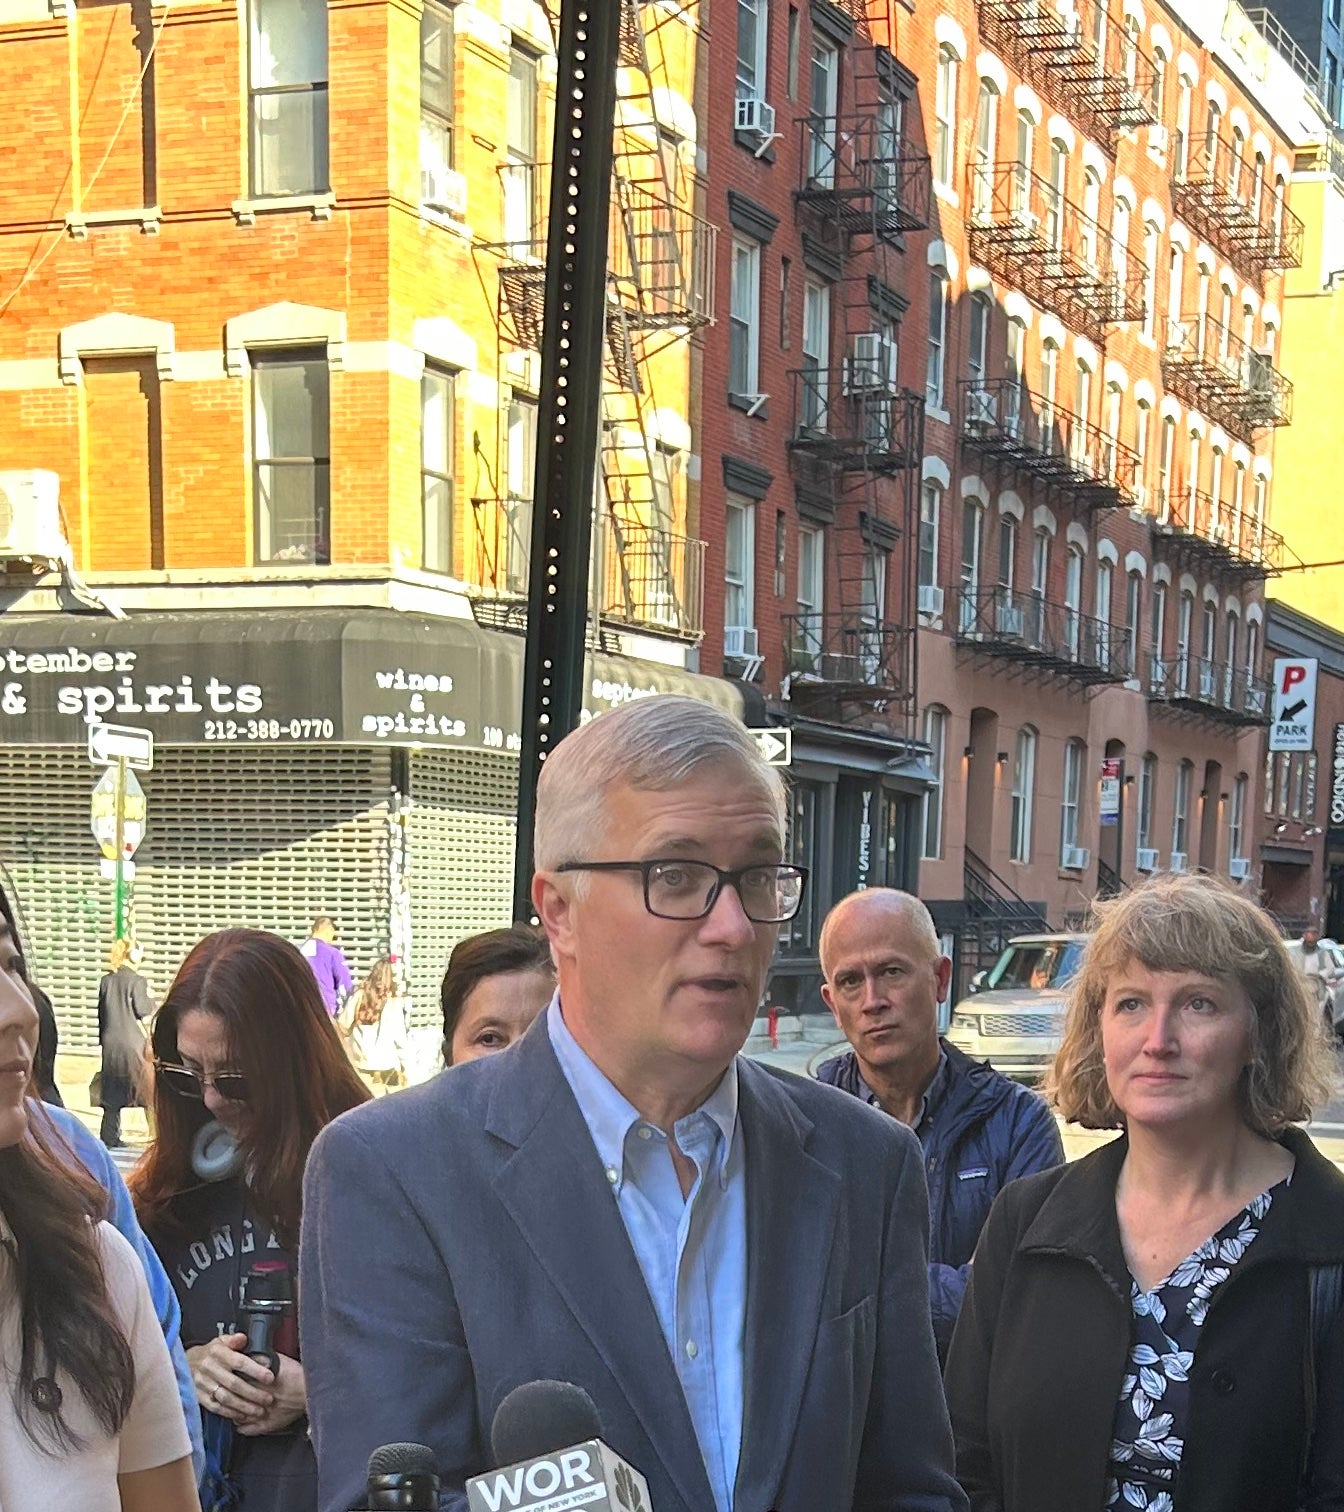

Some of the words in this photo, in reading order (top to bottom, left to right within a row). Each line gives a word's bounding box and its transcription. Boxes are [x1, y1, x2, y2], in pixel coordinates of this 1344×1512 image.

[375, 667, 454, 693] wines
[592, 678, 657, 708] septe
[1281, 666, 1307, 695] P
[1, 681, 27, 715] &
[57, 675, 263, 724] spirits
[410, 694, 425, 713] &
[204, 718, 334, 740] 212-388-0770
[362, 712, 466, 738] spirits
[1276, 725, 1308, 737] PARK
[476, 1450, 595, 1512] WOR
[547, 1499, 570, 1512] NEW
[571, 1489, 597, 1503] YORK
